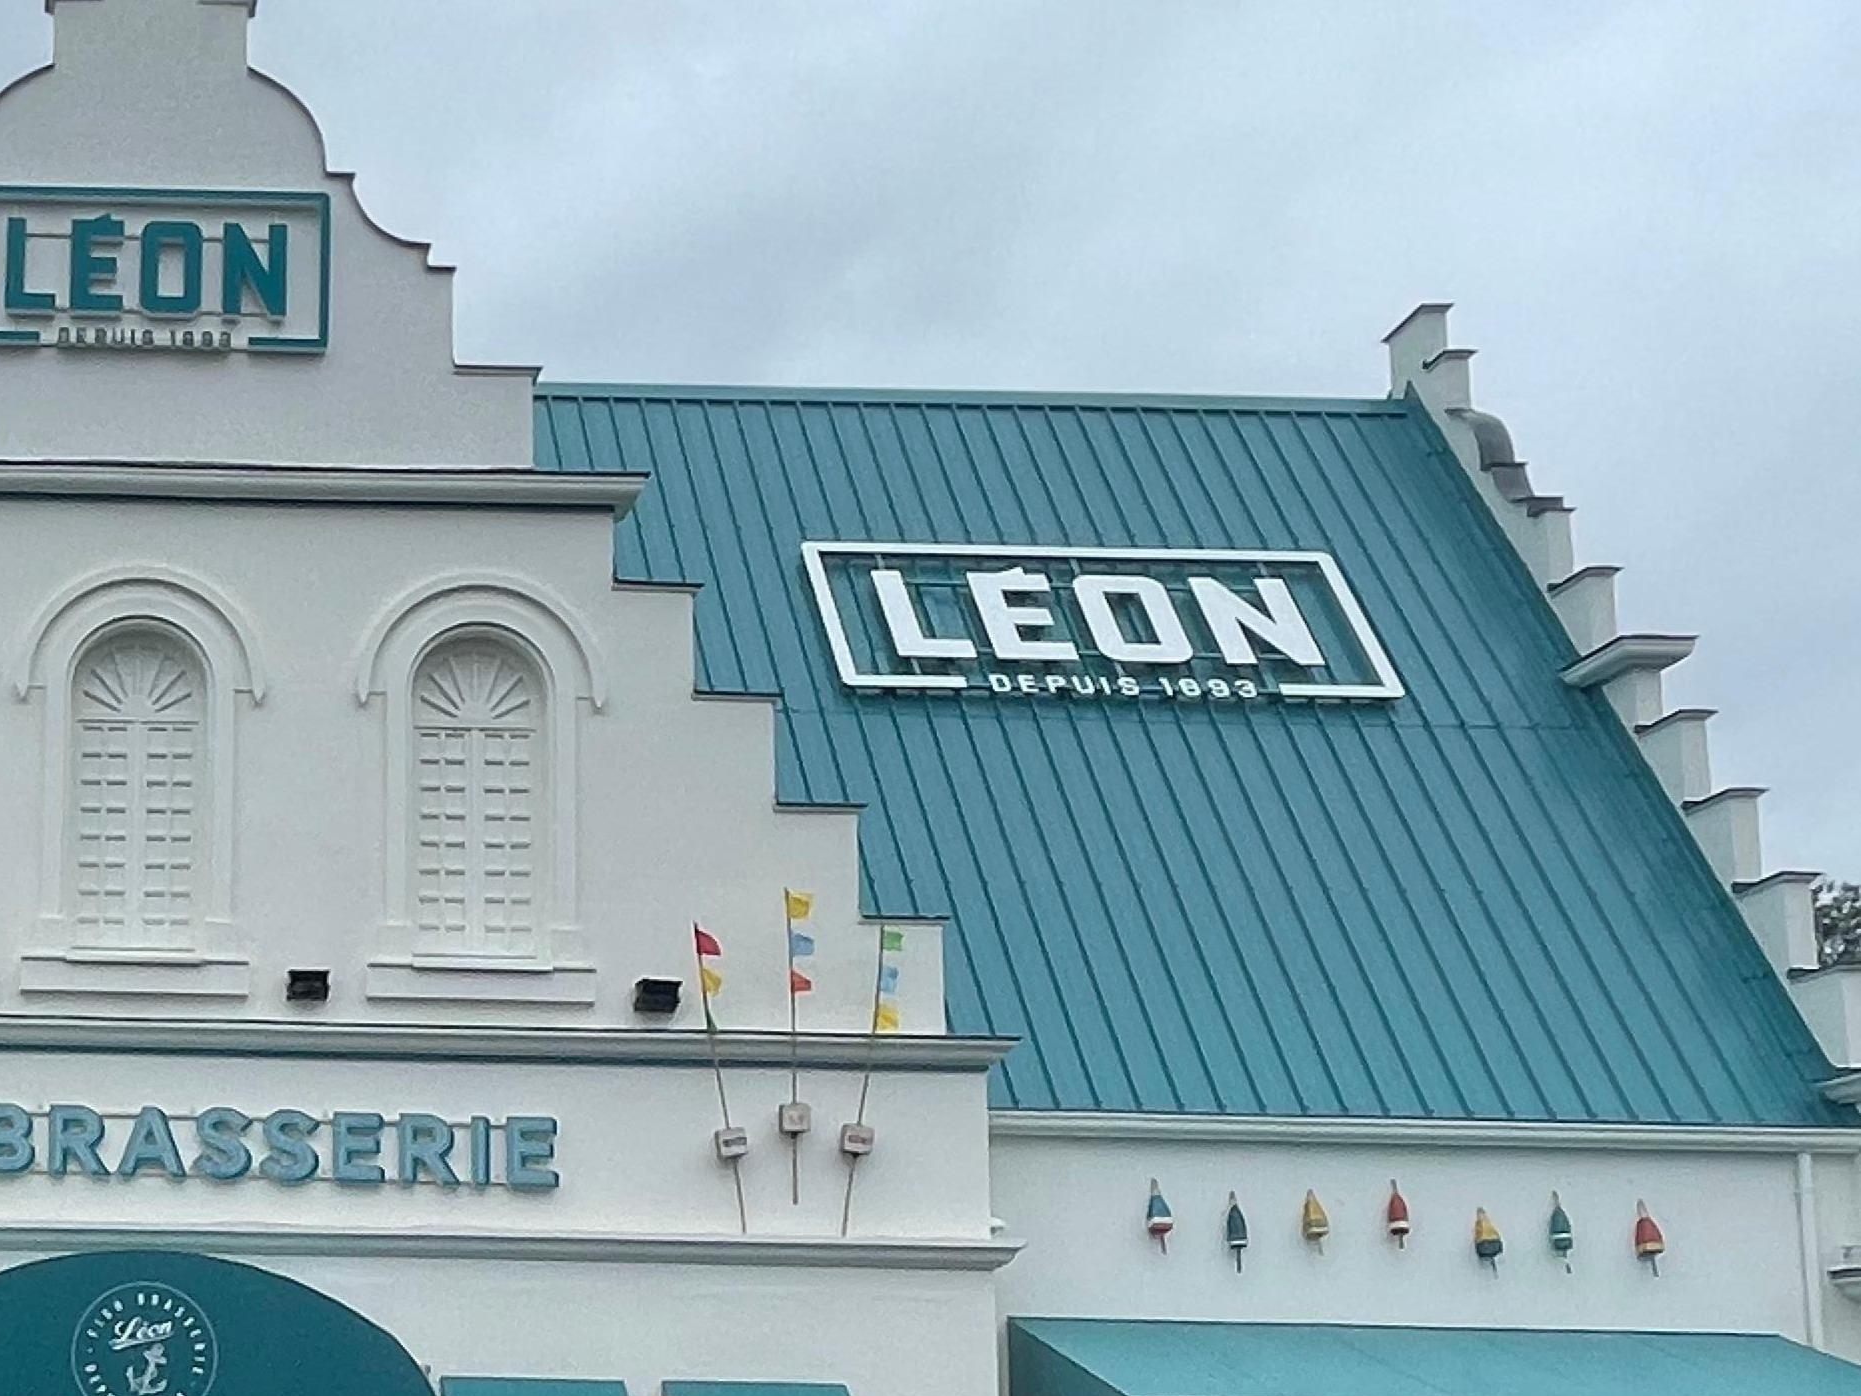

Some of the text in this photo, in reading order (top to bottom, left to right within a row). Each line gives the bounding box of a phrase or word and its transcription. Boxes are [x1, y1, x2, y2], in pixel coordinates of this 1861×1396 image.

[57, 326, 155, 348] DEPUIS
[988, 673, 1258, 699] DEPUIS 1893
